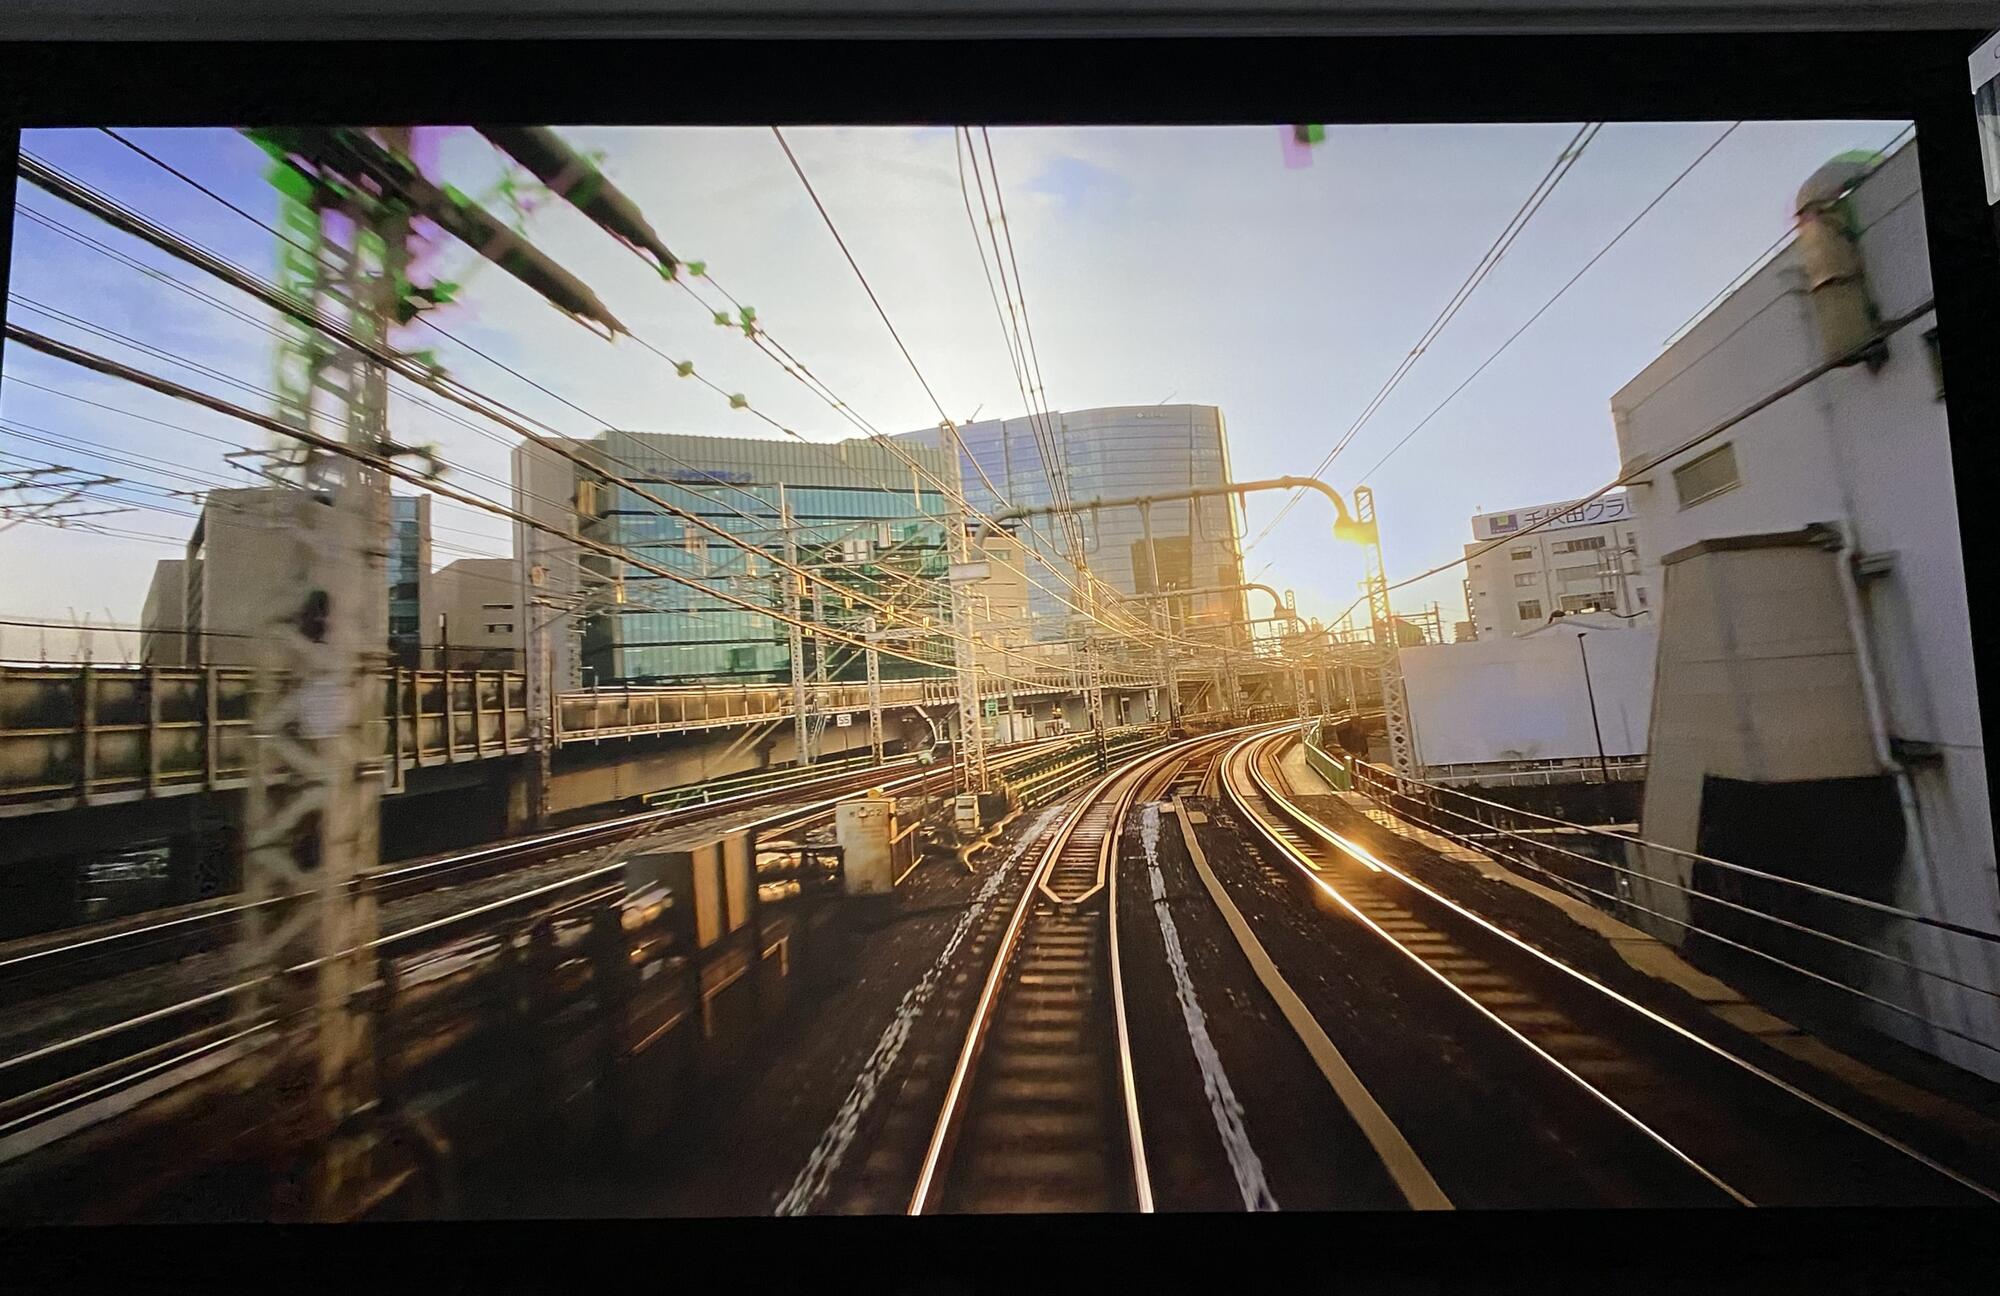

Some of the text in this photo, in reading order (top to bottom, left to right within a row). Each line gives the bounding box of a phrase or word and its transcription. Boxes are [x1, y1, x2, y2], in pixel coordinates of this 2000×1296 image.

[1524, 497, 1631, 526] 千代田グラ
